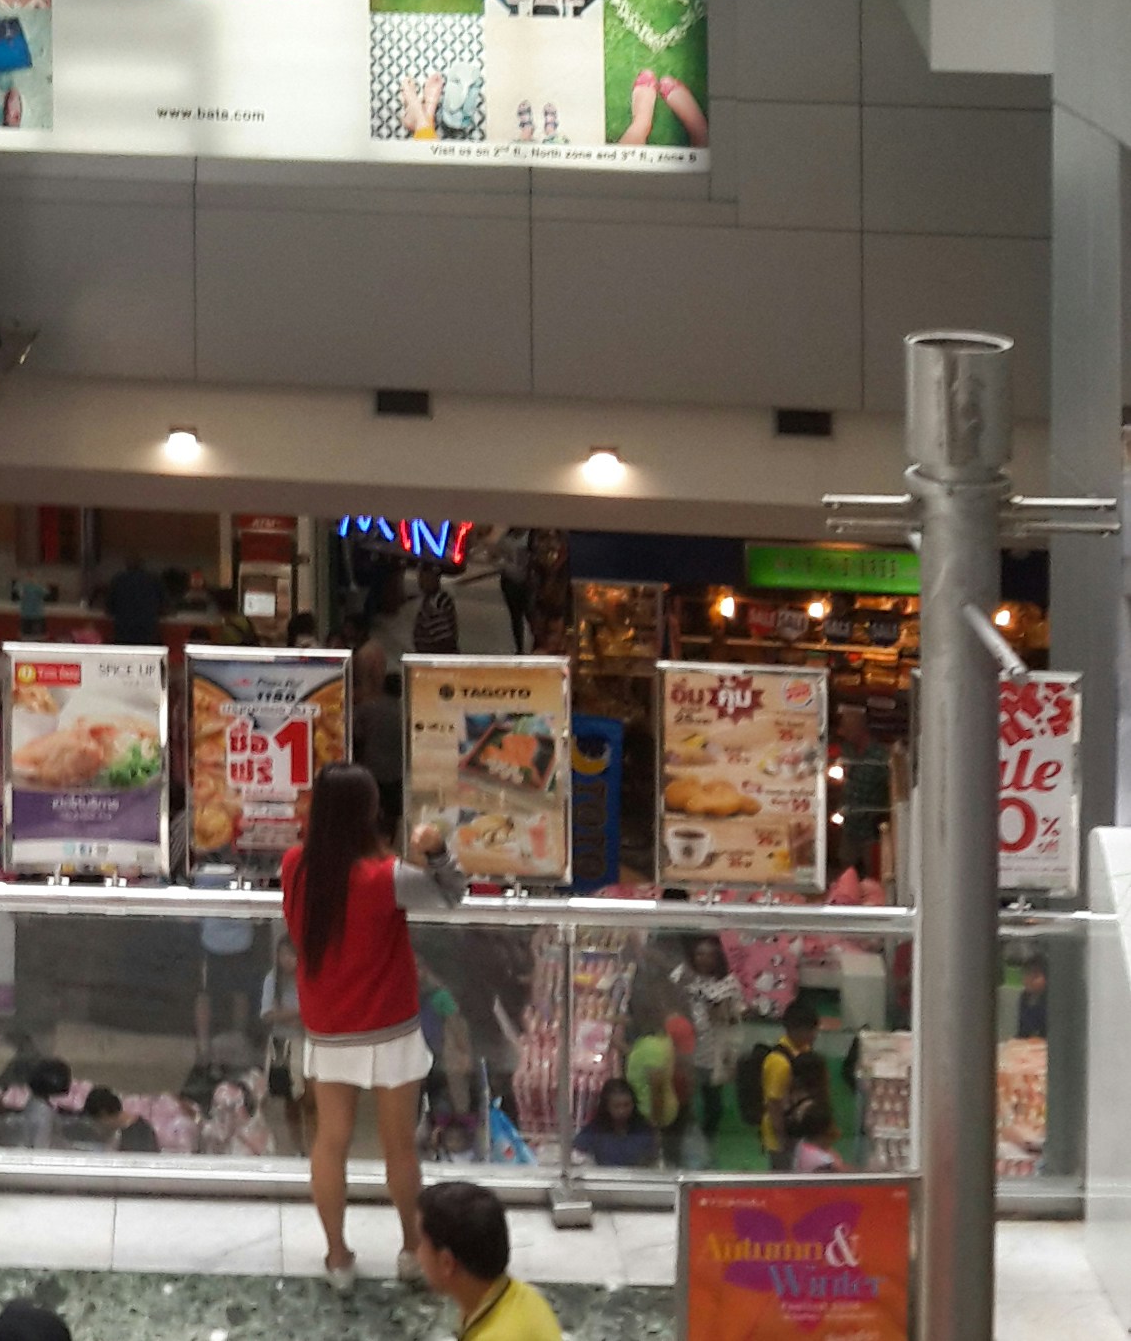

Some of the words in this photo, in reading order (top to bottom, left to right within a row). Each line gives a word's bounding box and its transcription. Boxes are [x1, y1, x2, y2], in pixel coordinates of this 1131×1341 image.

[273, 719, 310, 785] 1
[708, 1233, 824, 1261] Autumn
[769, 1265, 888, 1298] Winter
